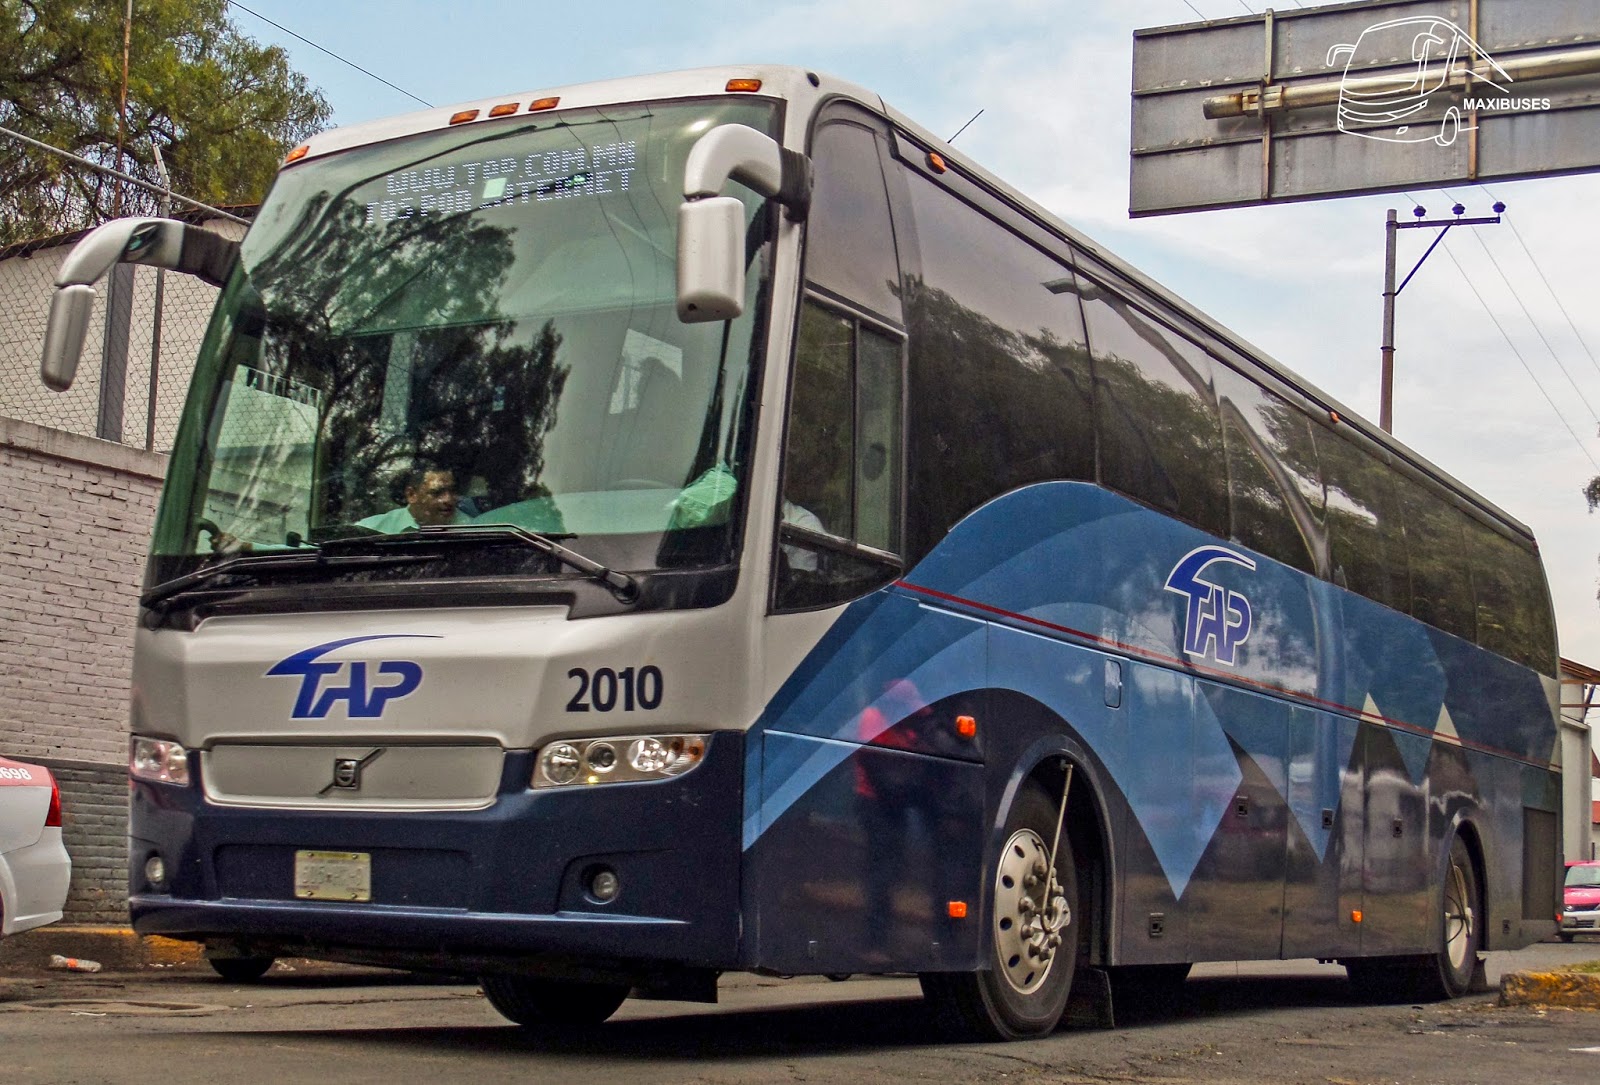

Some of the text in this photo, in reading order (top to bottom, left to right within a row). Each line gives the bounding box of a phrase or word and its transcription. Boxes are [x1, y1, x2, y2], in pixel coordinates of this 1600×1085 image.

[1163, 545, 1257, 666] TAP
[265, 634, 444, 720] TAP
[565, 664, 663, 713] 2010
[0, 766, 32, 780] 698
